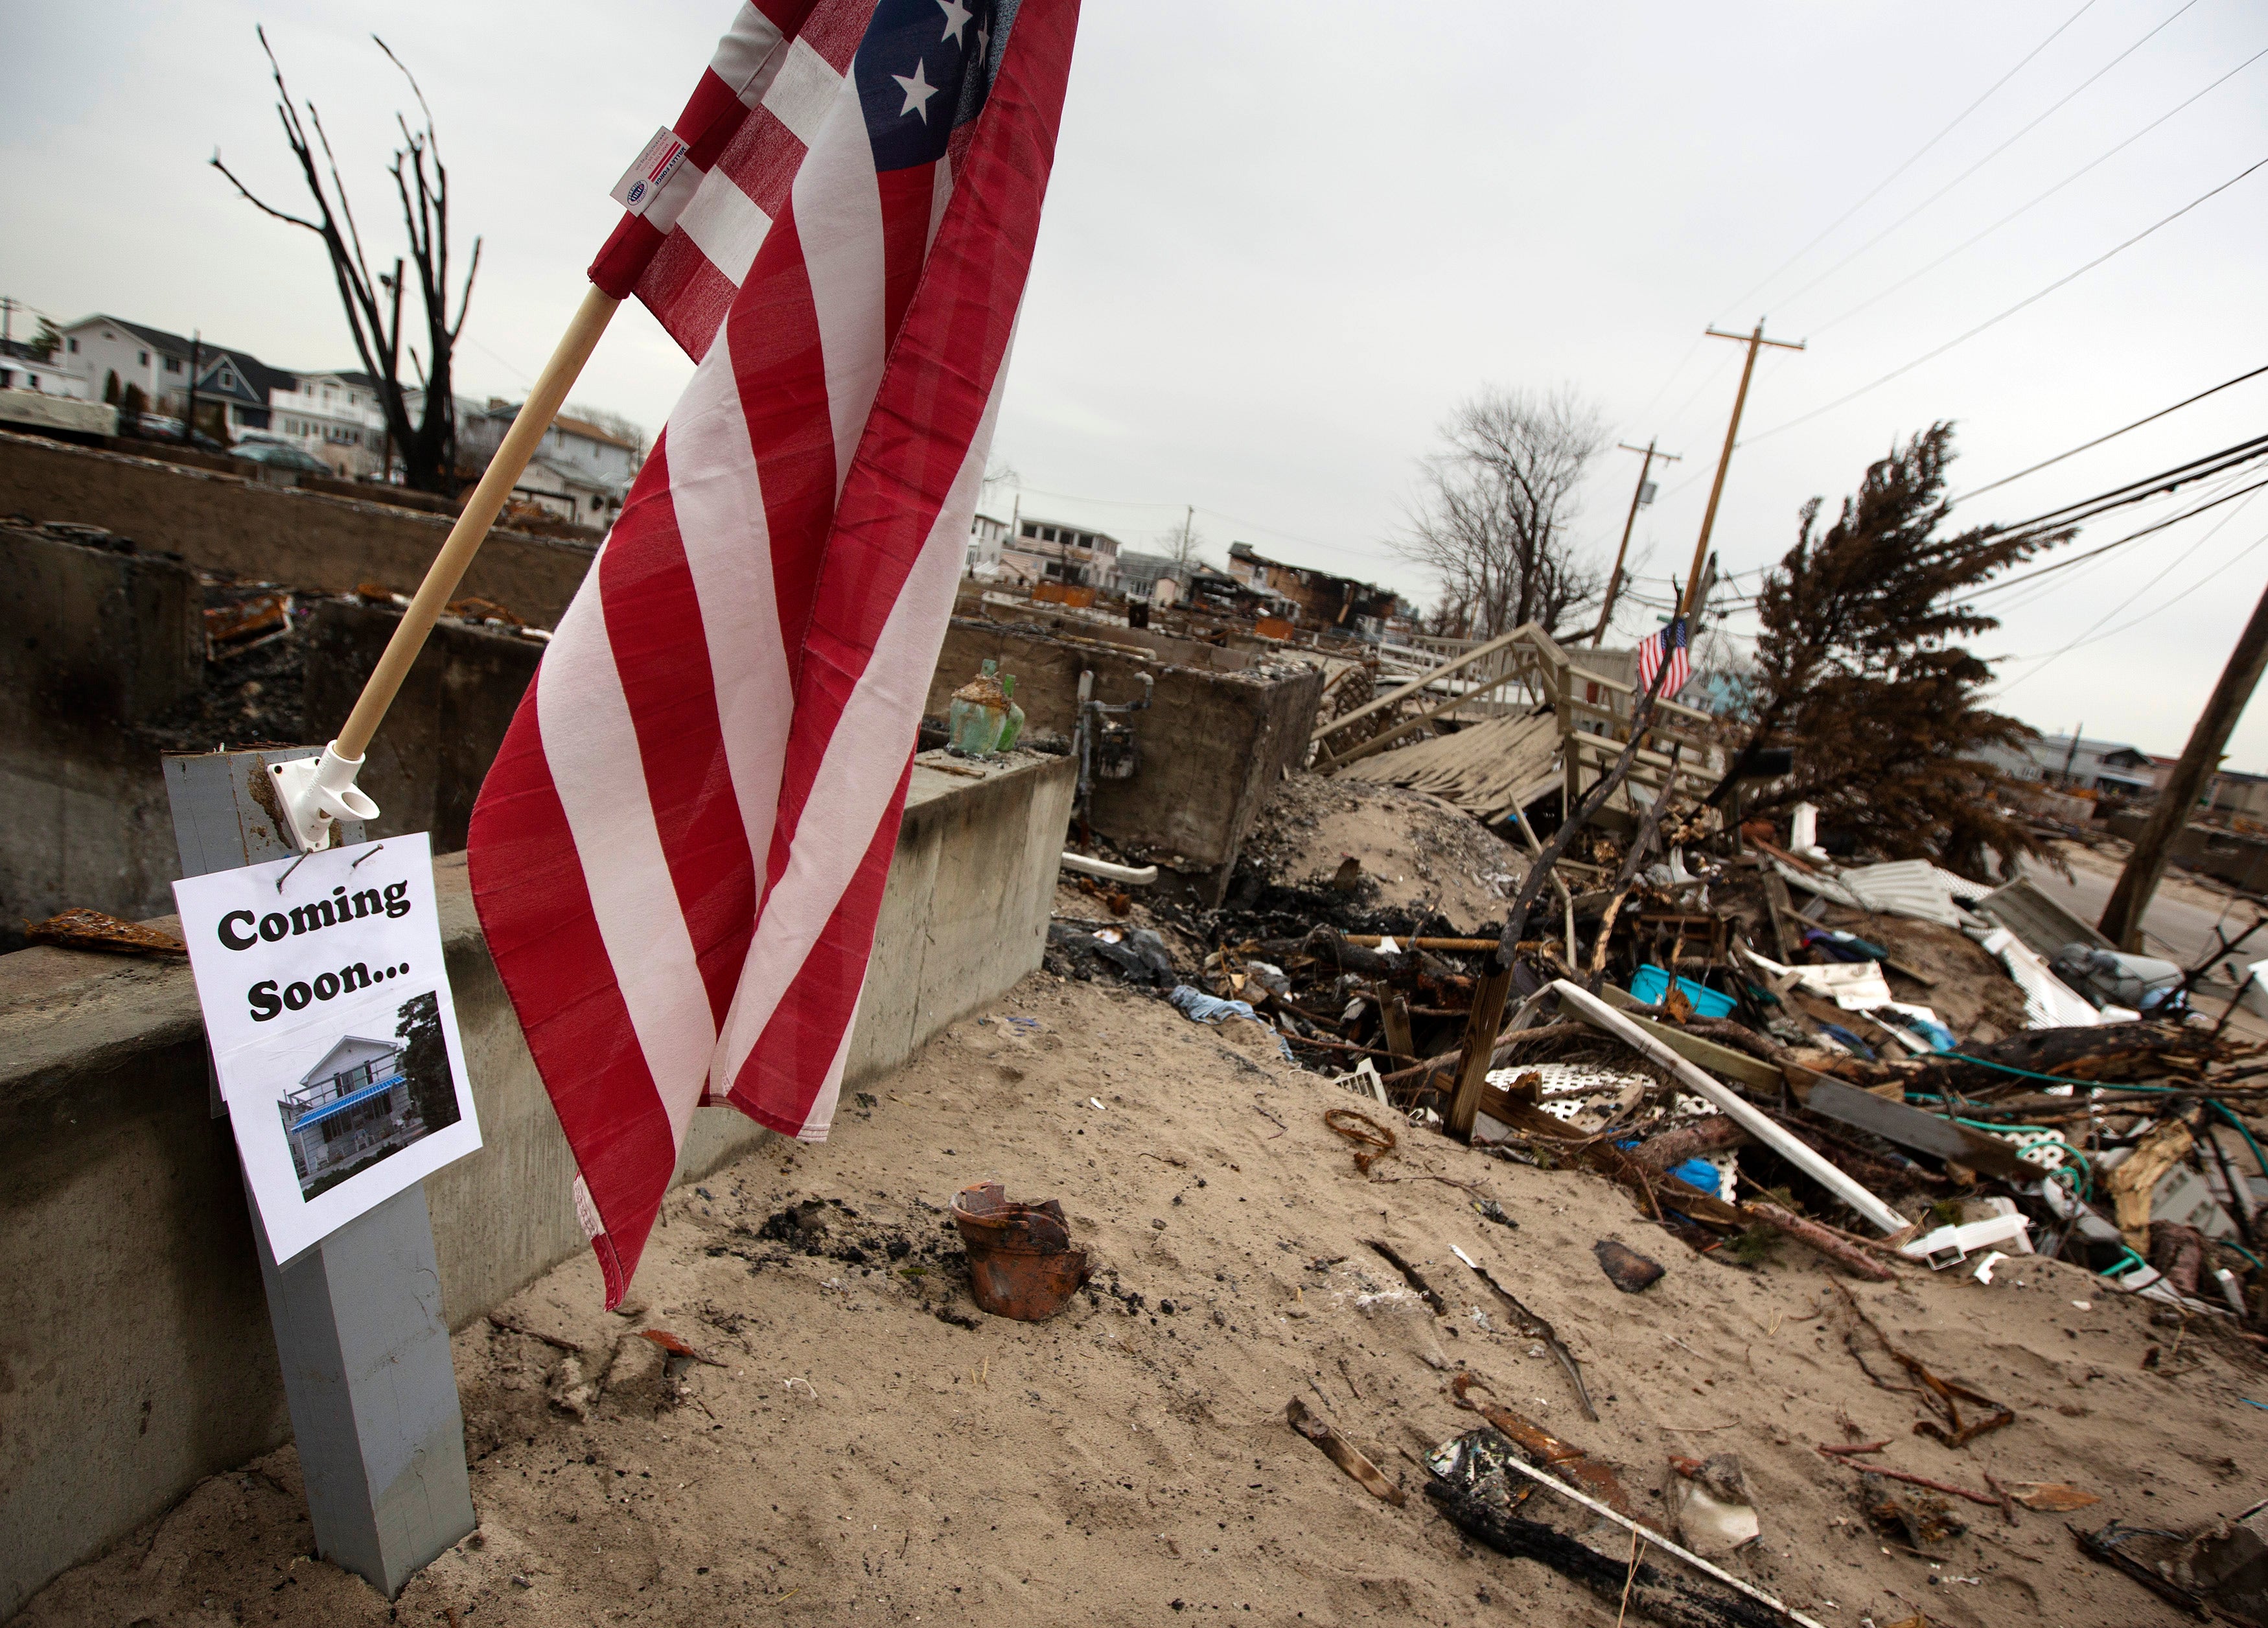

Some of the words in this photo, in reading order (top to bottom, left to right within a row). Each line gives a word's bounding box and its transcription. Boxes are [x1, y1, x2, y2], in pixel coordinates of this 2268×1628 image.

[654, 167, 670, 186] FORGE
[669, 147, 686, 168] VALLEY
[218, 879, 410, 951] Coming
[248, 962, 410, 1022] Soon...
